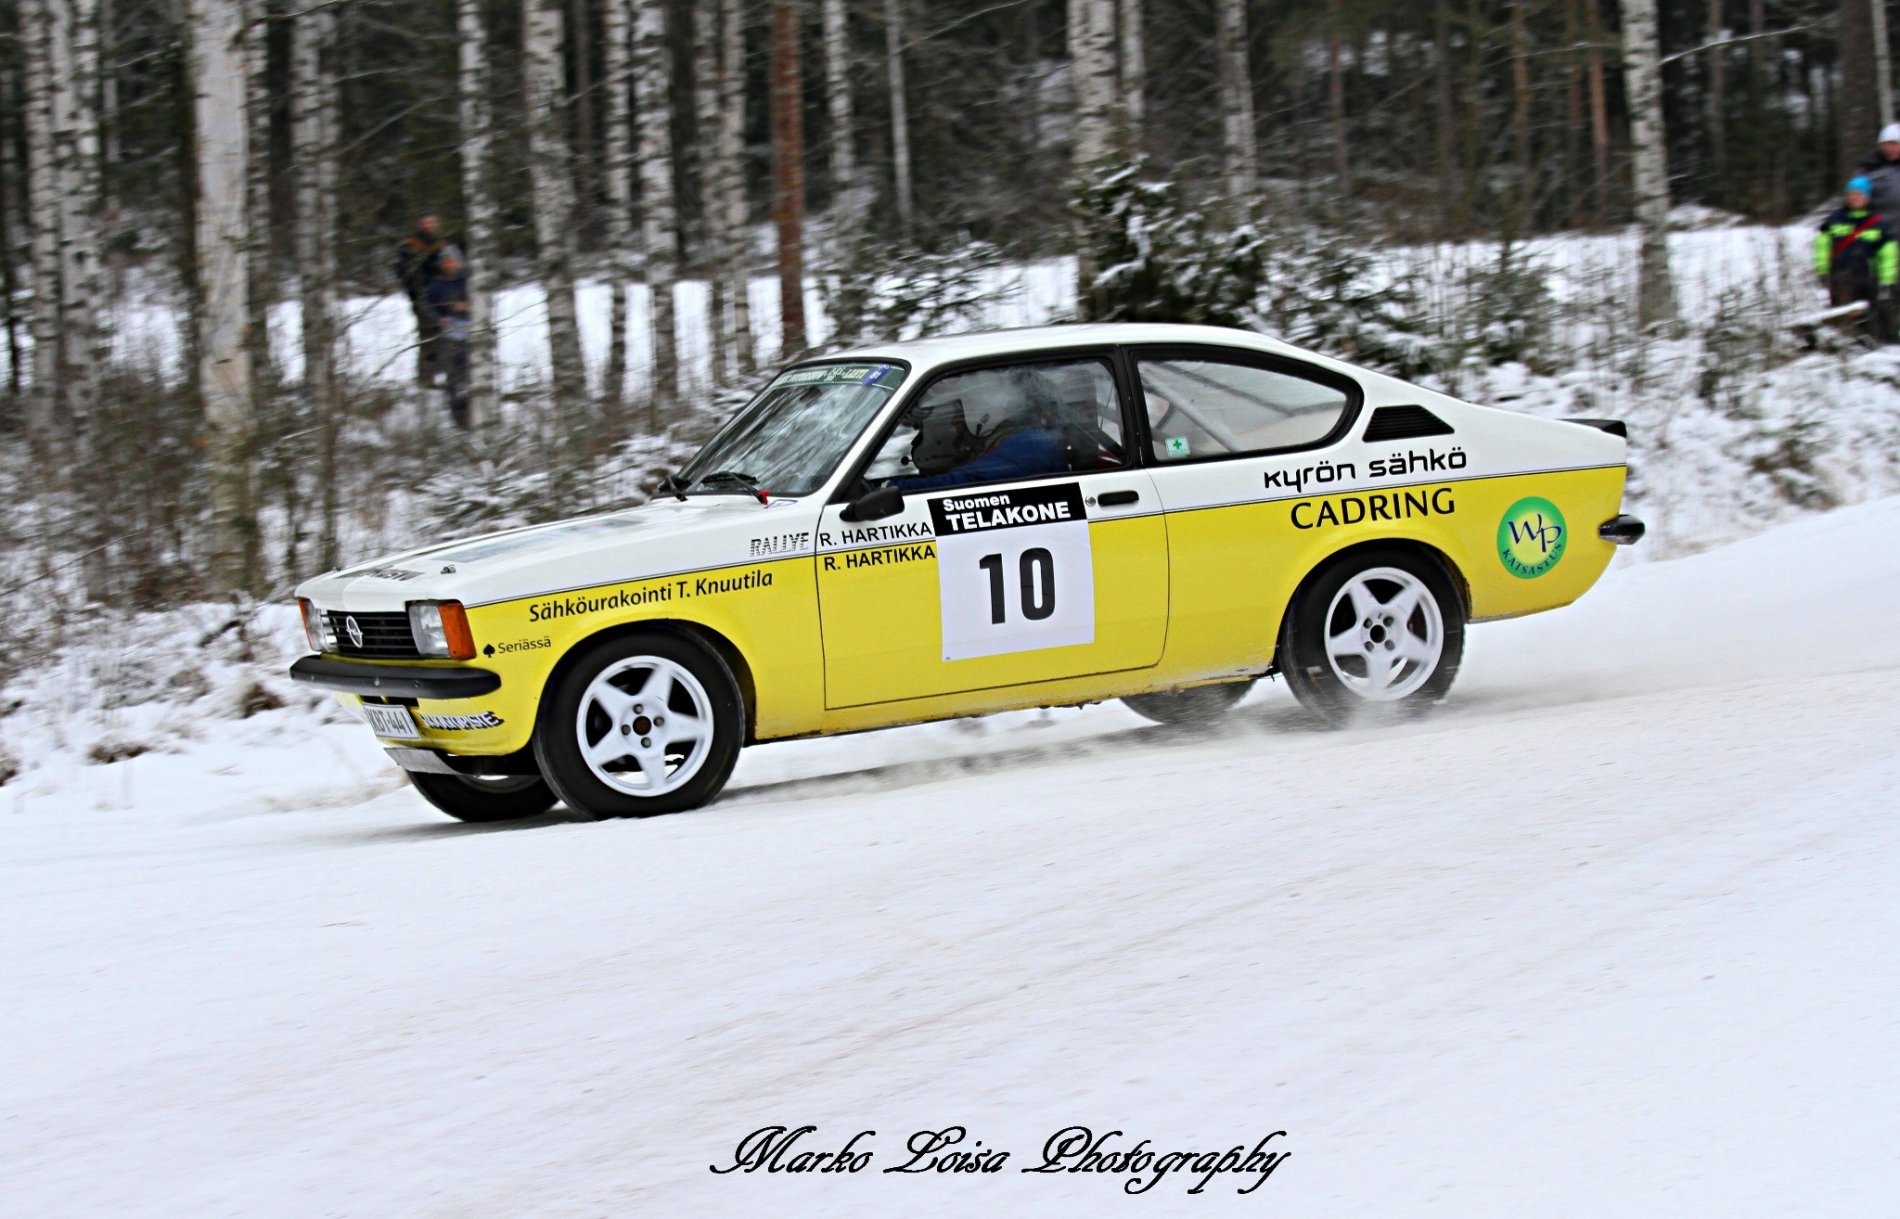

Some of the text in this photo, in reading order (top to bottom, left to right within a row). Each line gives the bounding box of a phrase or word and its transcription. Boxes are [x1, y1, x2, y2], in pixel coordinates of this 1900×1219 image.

[1263, 446, 1467, 493] kyrön sähkö
[942, 495, 1011, 512] Suomen
[945, 501, 1072, 532] TELAKONE
[1290, 487, 1456, 530] CADRING
[750, 532, 809, 556] RALLYE
[819, 521, 933, 547] R. HARTIKKA
[824, 544, 936, 572] R. HARTIKKA
[1502, 543, 1562, 575] KATSASTUS
[529, 569, 773, 623] Sähköurakointi T. Knuutila
[978, 546, 1056, 625] 10
[498, 635, 552, 654] Seriässä
[365, 707, 414, 735] KBT-441
